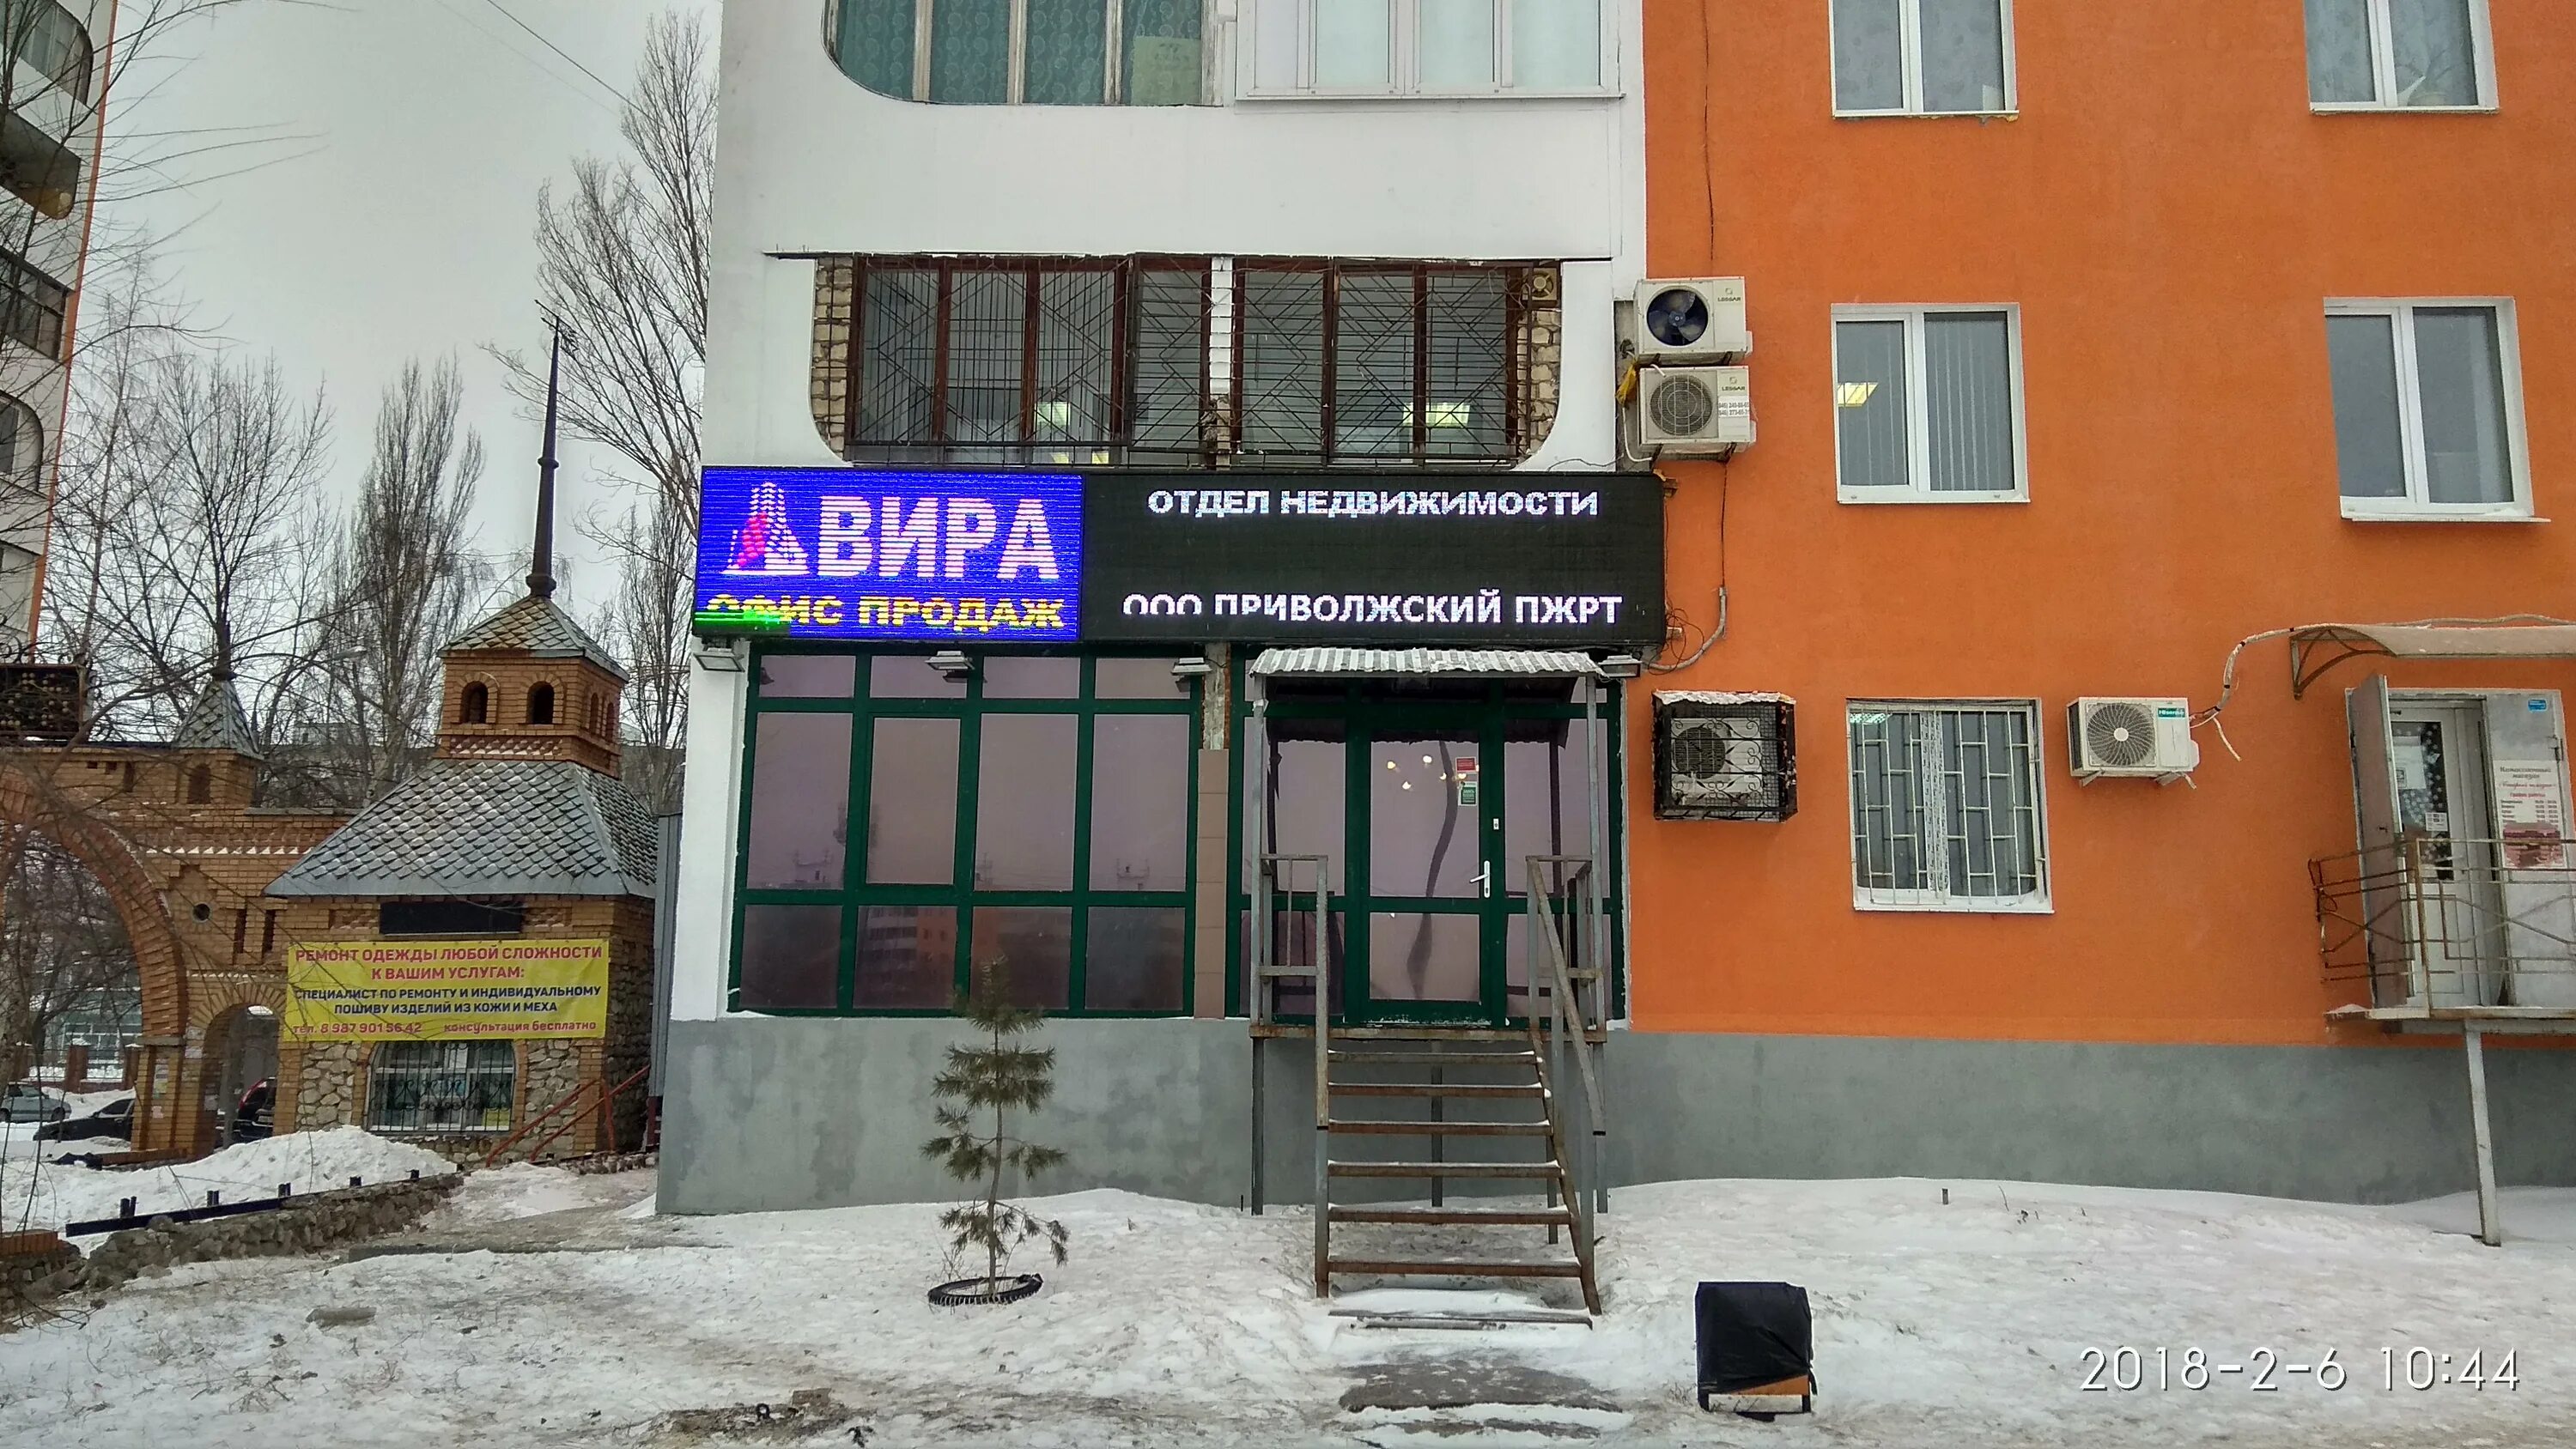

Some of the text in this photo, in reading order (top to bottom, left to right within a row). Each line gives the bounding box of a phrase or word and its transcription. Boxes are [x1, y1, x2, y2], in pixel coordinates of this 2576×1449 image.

[1148, 490, 1598, 518] ОТДЕЛ НЕДВИЖИМОСТИ
[817, 495, 1059, 579] ВИРА
[859, 596, 1065, 632] ПРОДАЖ
[1214, 589, 1501, 623] ПРИВОЛЖСКИЙ
[1515, 595, 1623, 623] ПЖРТ
[295, 945, 602, 963] РЕМОНТ ОДЕЖДЫ ЛЮБОЙ СЛОЖНОСТИ
[372, 967, 525, 979] К ВАШИМ УСЛУГАМ:
[295, 986, 601, 1001] СПЕЦИАЛИСТ ПО РЕМОНТУ И ИНДИВИДУАЛЬНОМУ
[334, 1002, 557, 1015] ПОШИВУ ИЗДЕЛИЙ ИЗ КОЖИ И МЕХА
[320, 1023, 329, 1033] 8
[332, 1023, 356, 1033] 987
[359, 1023, 383, 1033] 901
[404, 1022, 422, 1033] 42
[444, 1022, 529, 1034] консультация
[532, 1021, 596, 1031] бесплатно
